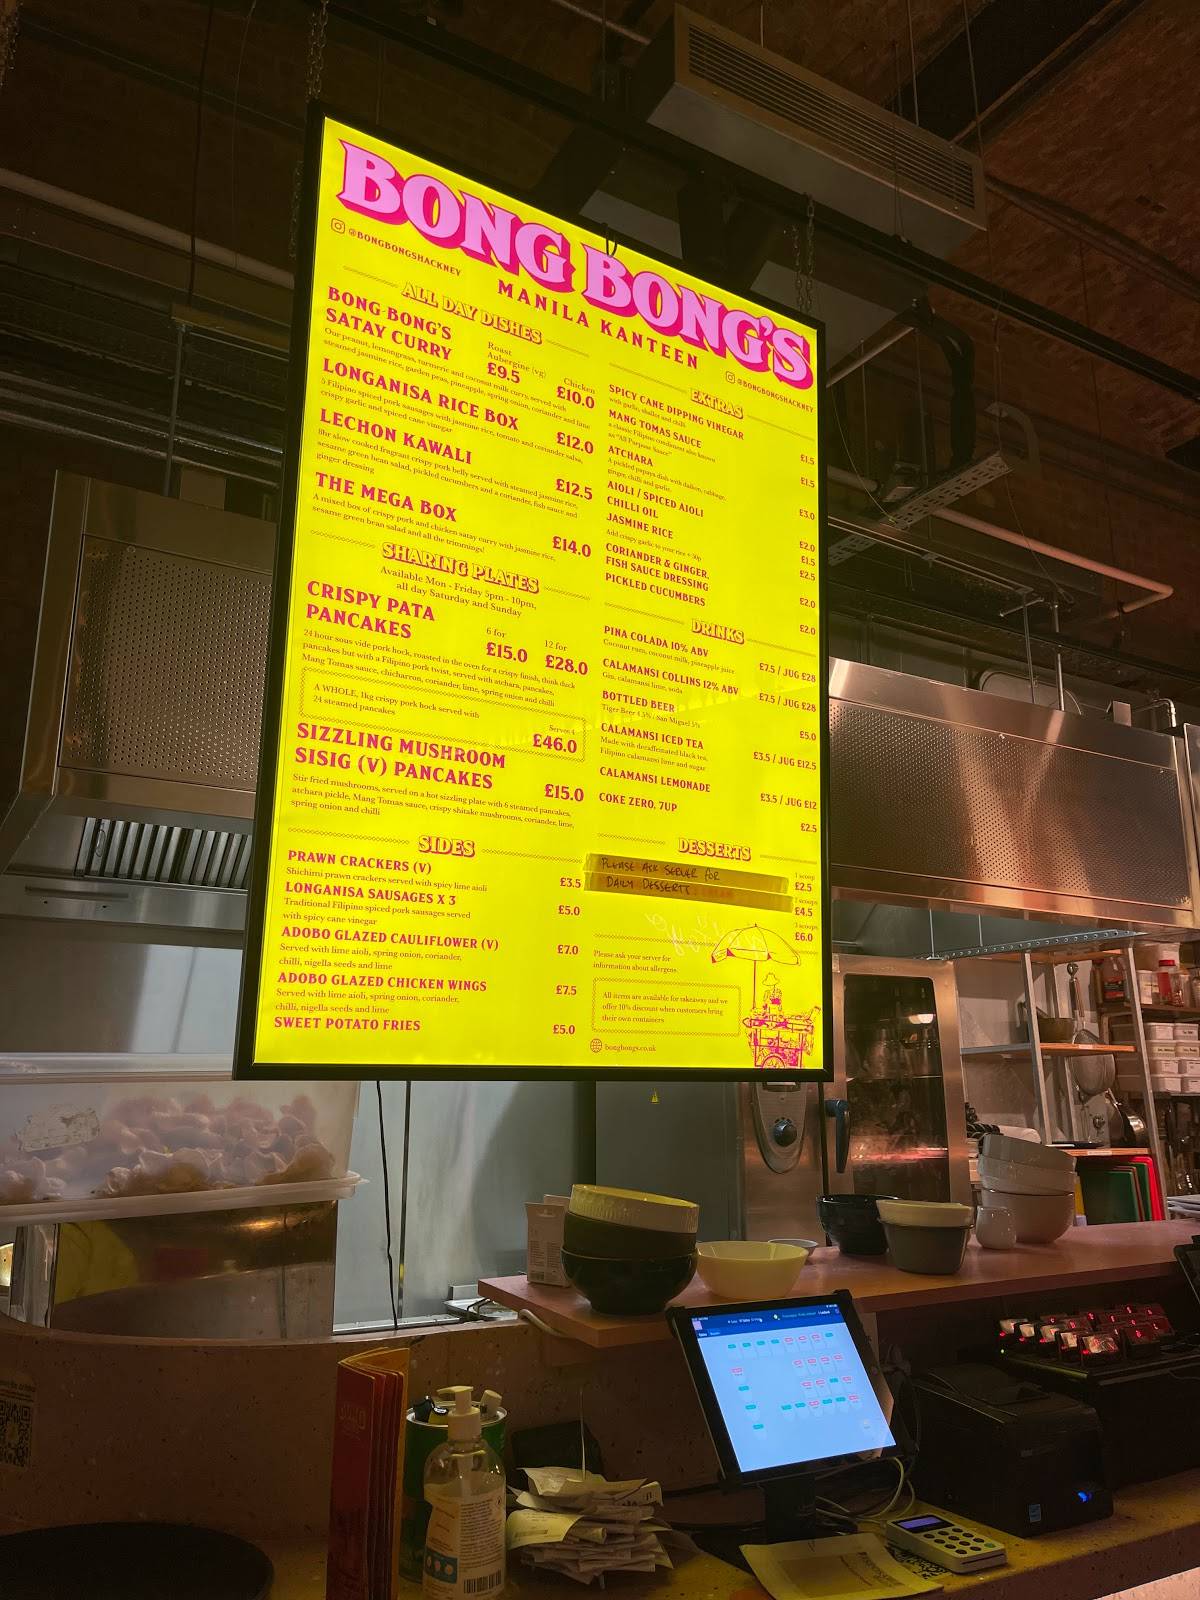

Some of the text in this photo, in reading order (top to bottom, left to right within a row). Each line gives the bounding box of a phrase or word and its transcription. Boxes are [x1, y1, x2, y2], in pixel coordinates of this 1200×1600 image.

[335, 138, 577, 294] BONG
[327, 286, 381, 316] BONG
[400, 284, 543, 346] ALL DAY DISHES
[497, 279, 698, 370] MANILA KANTEEN
[326, 307, 453, 361] SATAY CURRY
[487, 341, 512, 357] Roast
[487, 361, 521, 384] £9.5
[323, 357, 519, 431] LONGANISA RICE BOX
[556, 385, 595, 409] £10.0
[563, 377, 596, 395] Chicken
[609, 383, 744, 441] SPICY CANE DIPPING VINEGAR
[690, 390, 744, 420] EXTRAS
[319, 408, 472, 465] LECHON KAWALI
[608, 409, 702, 449] MANG TOMAS SAUCE
[556, 431, 594, 455] £12.0
[607, 445, 654, 468] ATCHARA
[315, 471, 457, 523] THE MEGA BOX
[555, 478, 593, 501] £12.5
[607, 480, 634, 496] AIOLI
[643, 491, 677, 509] SPICED
[678, 502, 704, 518] AIOLI
[606, 495, 659, 519] CHILLI OIL
[799, 508, 816, 521] £3.0
[606, 512, 673, 540] JASMINE RICE
[552, 535, 592, 558] £14.0
[605, 542, 662, 566] CORIANDER
[663, 559, 671, 569] &
[799, 540, 816, 553] £2.0
[382, 543, 540, 595] SHARING PLATES
[605, 555, 709, 592] FISH SAUCE DRESSING
[380, 565, 424, 583] Available
[425, 575, 447, 588] Mon
[454, 582, 483, 598] Friday
[484, 590, 504, 602] 5pm
[605, 572, 706, 607] PICKLED CUCUMBERS
[307, 580, 435, 622] CRISPY PATA
[396, 581, 522, 619] all day Saturday and Sunday
[306, 603, 412, 639] PANCAKES
[486, 627, 507, 639] 6 for
[691, 620, 745, 646] DRINKS
[485, 641, 528, 663] £15.0
[544, 639, 568, 652] 12 for
[630, 631, 669, 649] COLADA
[671, 641, 689, 653] 10%
[690, 646, 709, 658] ABV
[544, 654, 589, 676] £28.0
[602, 658, 739, 695] CALAMANSI COLLINS 12% ABV
[602, 690, 675, 713] BOTTLED BEER
[297, 722, 506, 769] SIZZLING MUSHROOM
[532, 733, 578, 754] £46.0
[600, 722, 704, 750] CALAMANSI ICED TEA
[799, 730, 817, 742] £5.0
[295, 746, 493, 790] SISIG (V) PANCAKES
[599, 766, 711, 793] CALAMANSI LEMONADE
[544, 783, 585, 802] £15.0
[598, 792, 626, 805] COKE
[658, 801, 678, 812] 7UP
[290, 799, 381, 816] spring onion and chilli
[800, 822, 818, 833] £2.5
[418, 835, 476, 859] SIDES
[678, 839, 752, 862] DESSERTS
[287, 849, 432, 875] PRAWN CRACKERS (V)
[285, 881, 456, 906] LONGANISA SAUSAGES X 3
[559, 876, 582, 889] £3.5
[794, 881, 813, 893] £2.5
[282, 911, 302, 920] with
[303, 913, 326, 924] spicy
[347, 916, 378, 927] vinegar
[558, 904, 581, 916] £5.0
[794, 906, 813, 917] £4.5
[281, 926, 499, 951] ADOBO GLAZED CAULIFLOWER (V)
[794, 931, 814, 942] £6.0
[557, 944, 579, 956] £7.0
[277, 971, 487, 992] ADOBO GLAZED CHICKEN WINGS
[555, 984, 577, 996] £7.5
[274, 1016, 421, 1032] SWEET POTATO FRIES
[552, 1024, 576, 1035] £5.0
